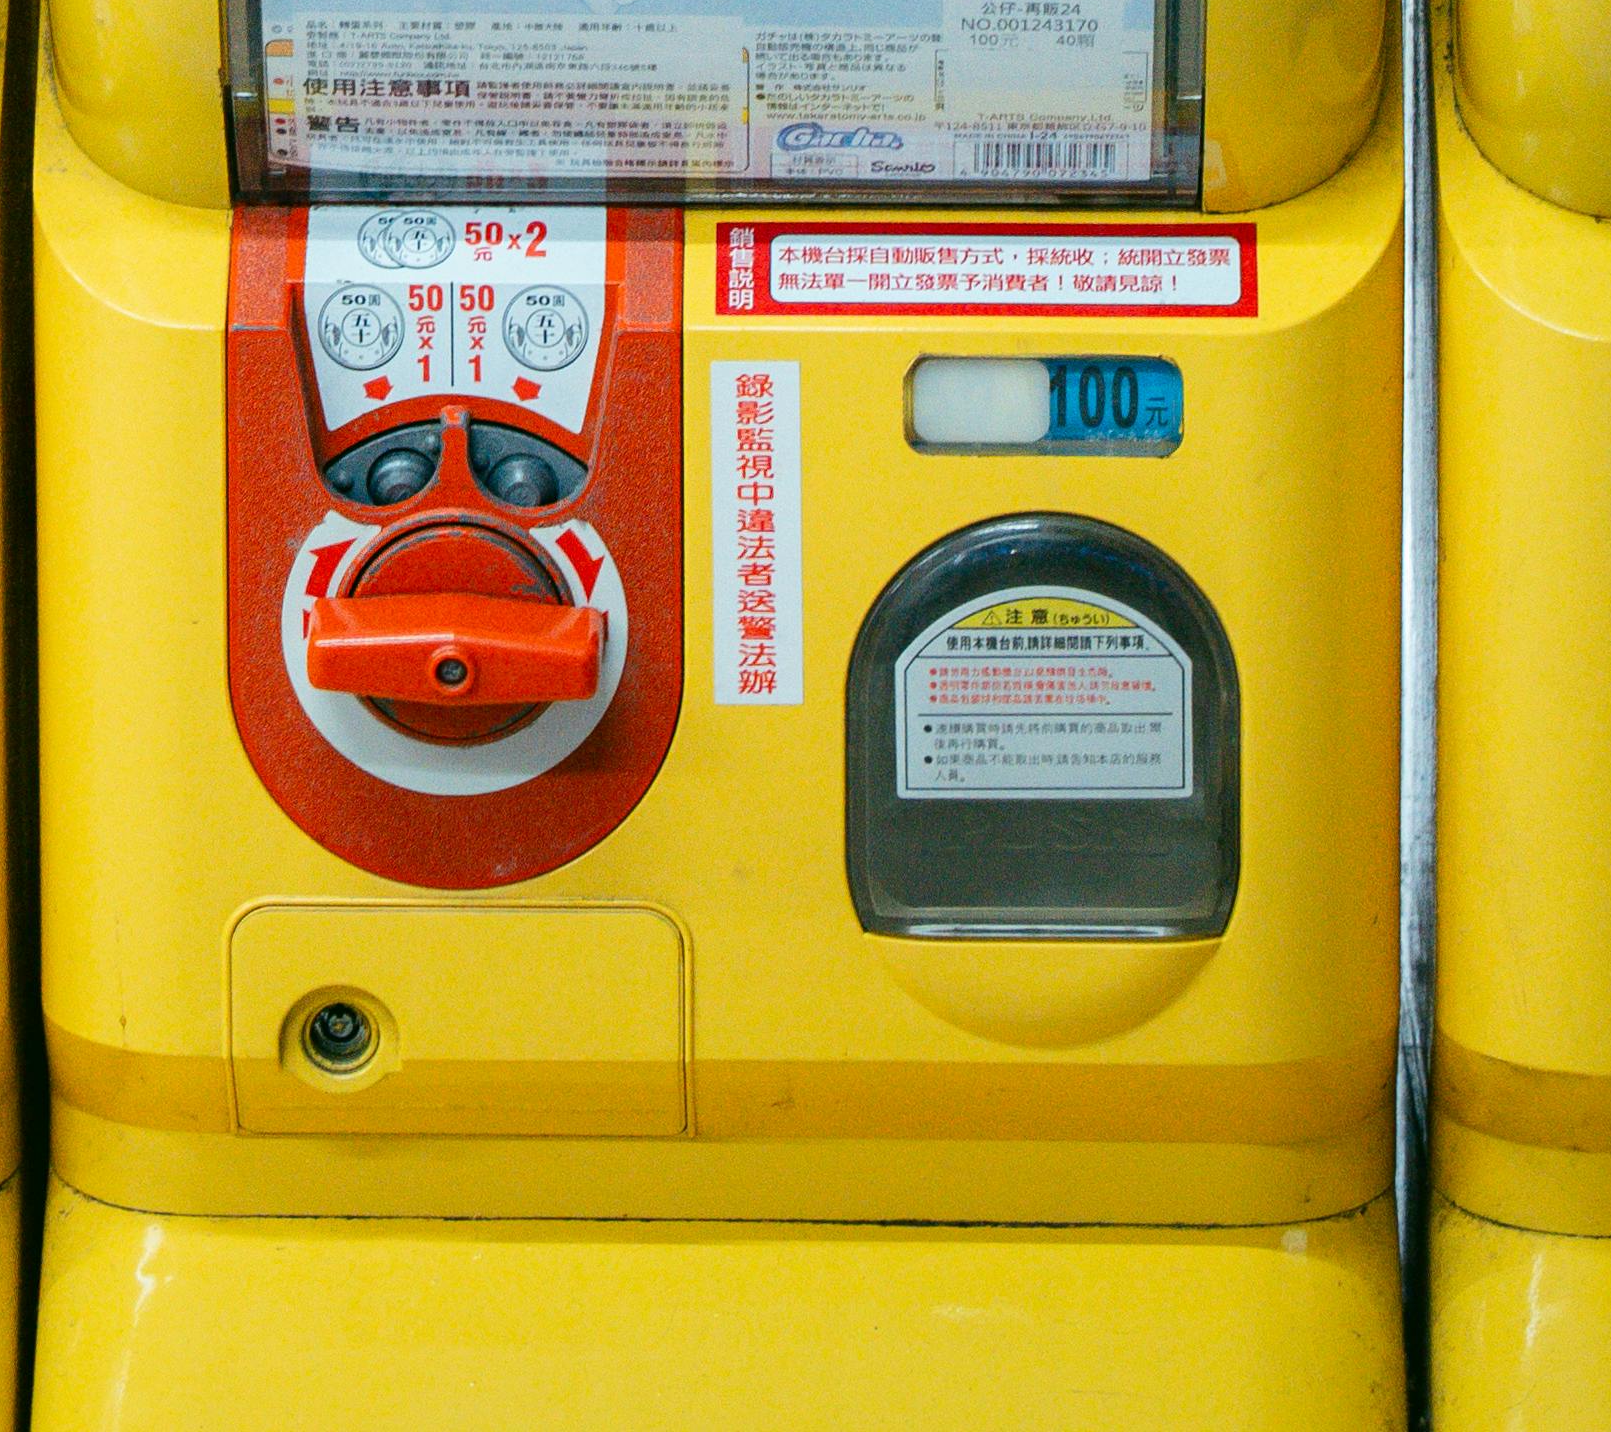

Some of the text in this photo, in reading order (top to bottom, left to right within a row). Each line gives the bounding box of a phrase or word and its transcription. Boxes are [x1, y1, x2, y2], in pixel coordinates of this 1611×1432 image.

[961, 17, 1099, 33] NO.001243170
[302, 78, 472, 98] 使用注意事項
[306, 114, 361, 134] 警告
